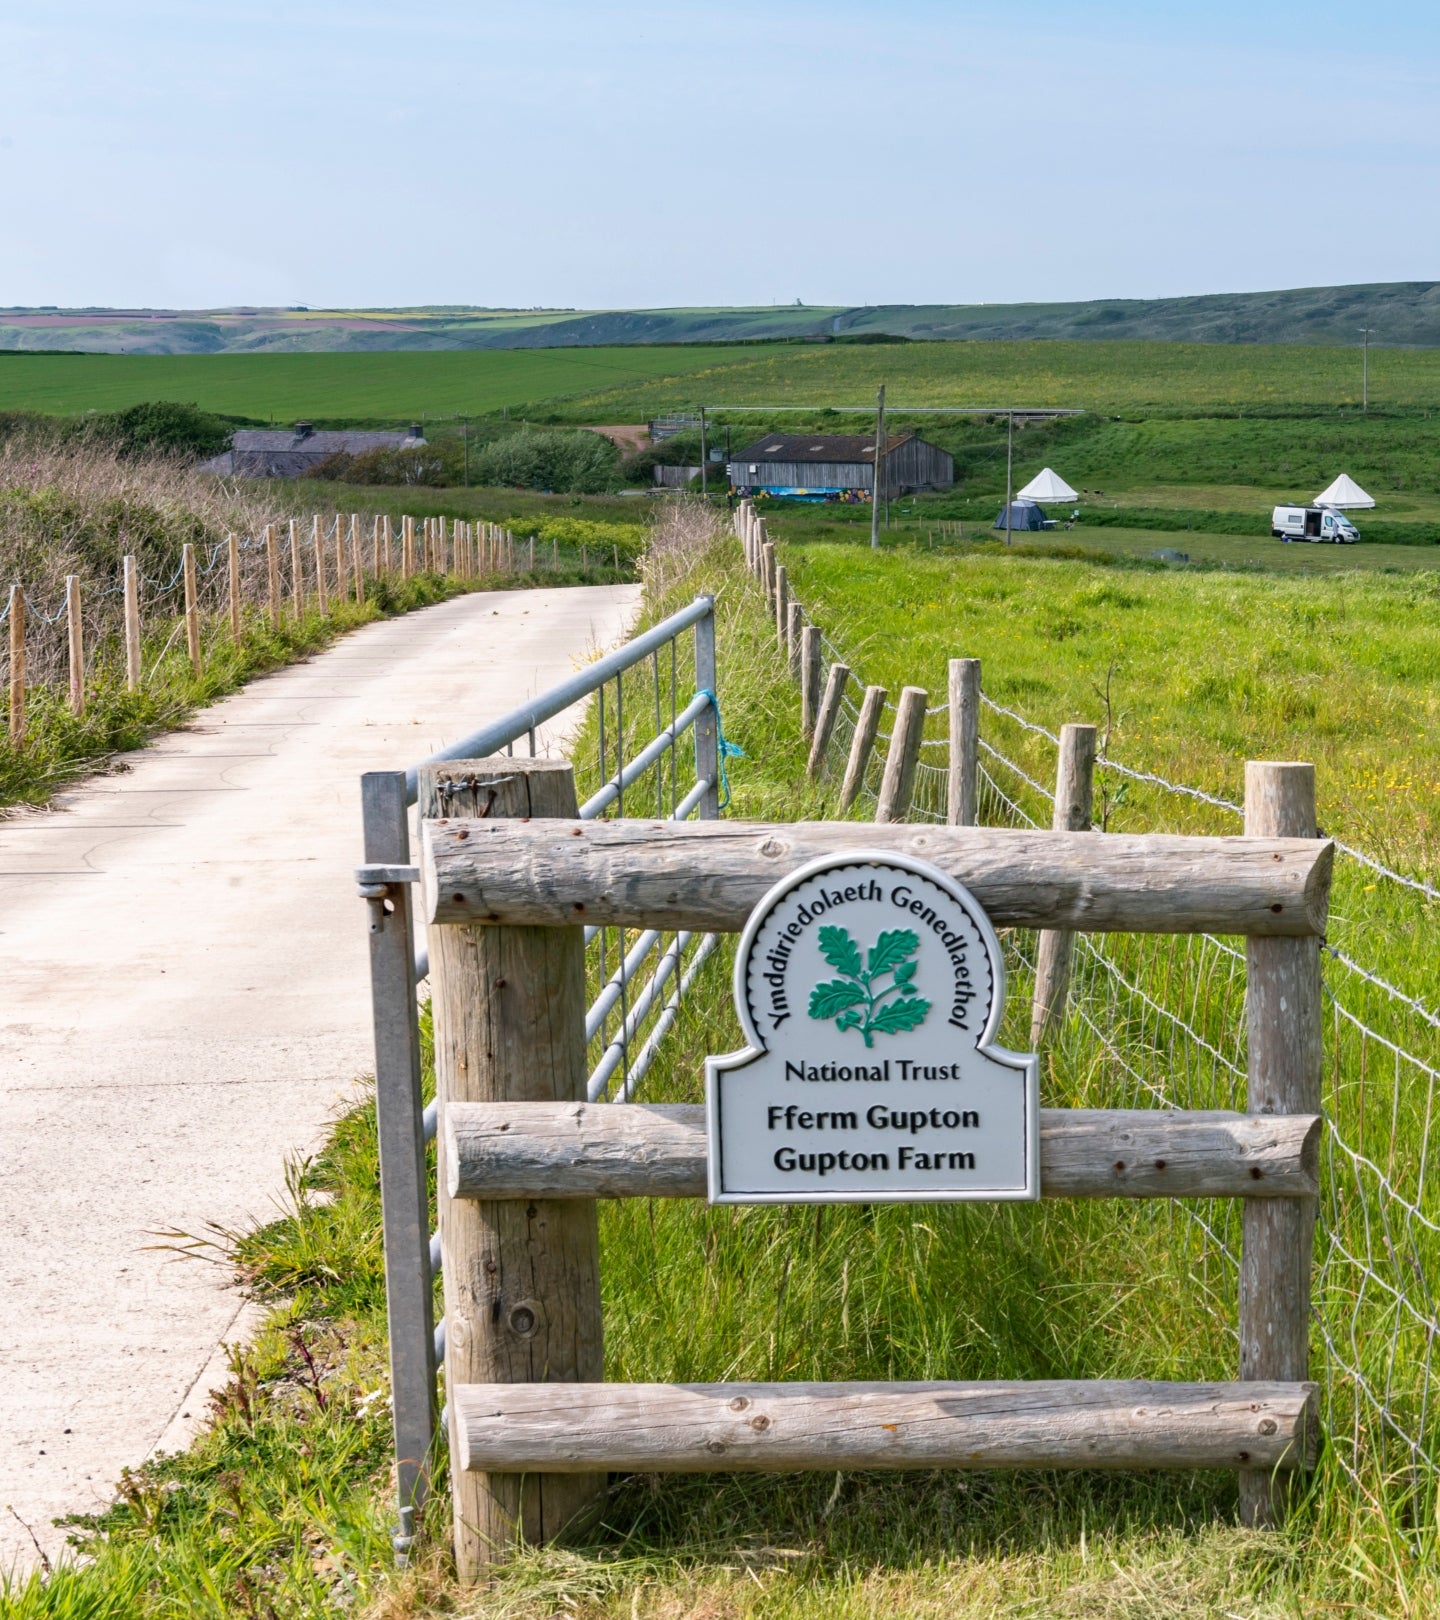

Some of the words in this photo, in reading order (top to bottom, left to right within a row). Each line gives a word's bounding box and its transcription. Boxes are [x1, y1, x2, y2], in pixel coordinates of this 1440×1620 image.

[763, 879, 882, 1031] Ymddiriedolaeth
[890, 885, 977, 1031] Genedlaethol
[785, 1060, 889, 1082] National
[895, 1060, 961, 1082] Trust
[767, 1105, 858, 1130] Fferm
[866, 1105, 980, 1135] Gupton
[773, 1147, 890, 1176] Gupton
[898, 1147, 976, 1171] Farm
